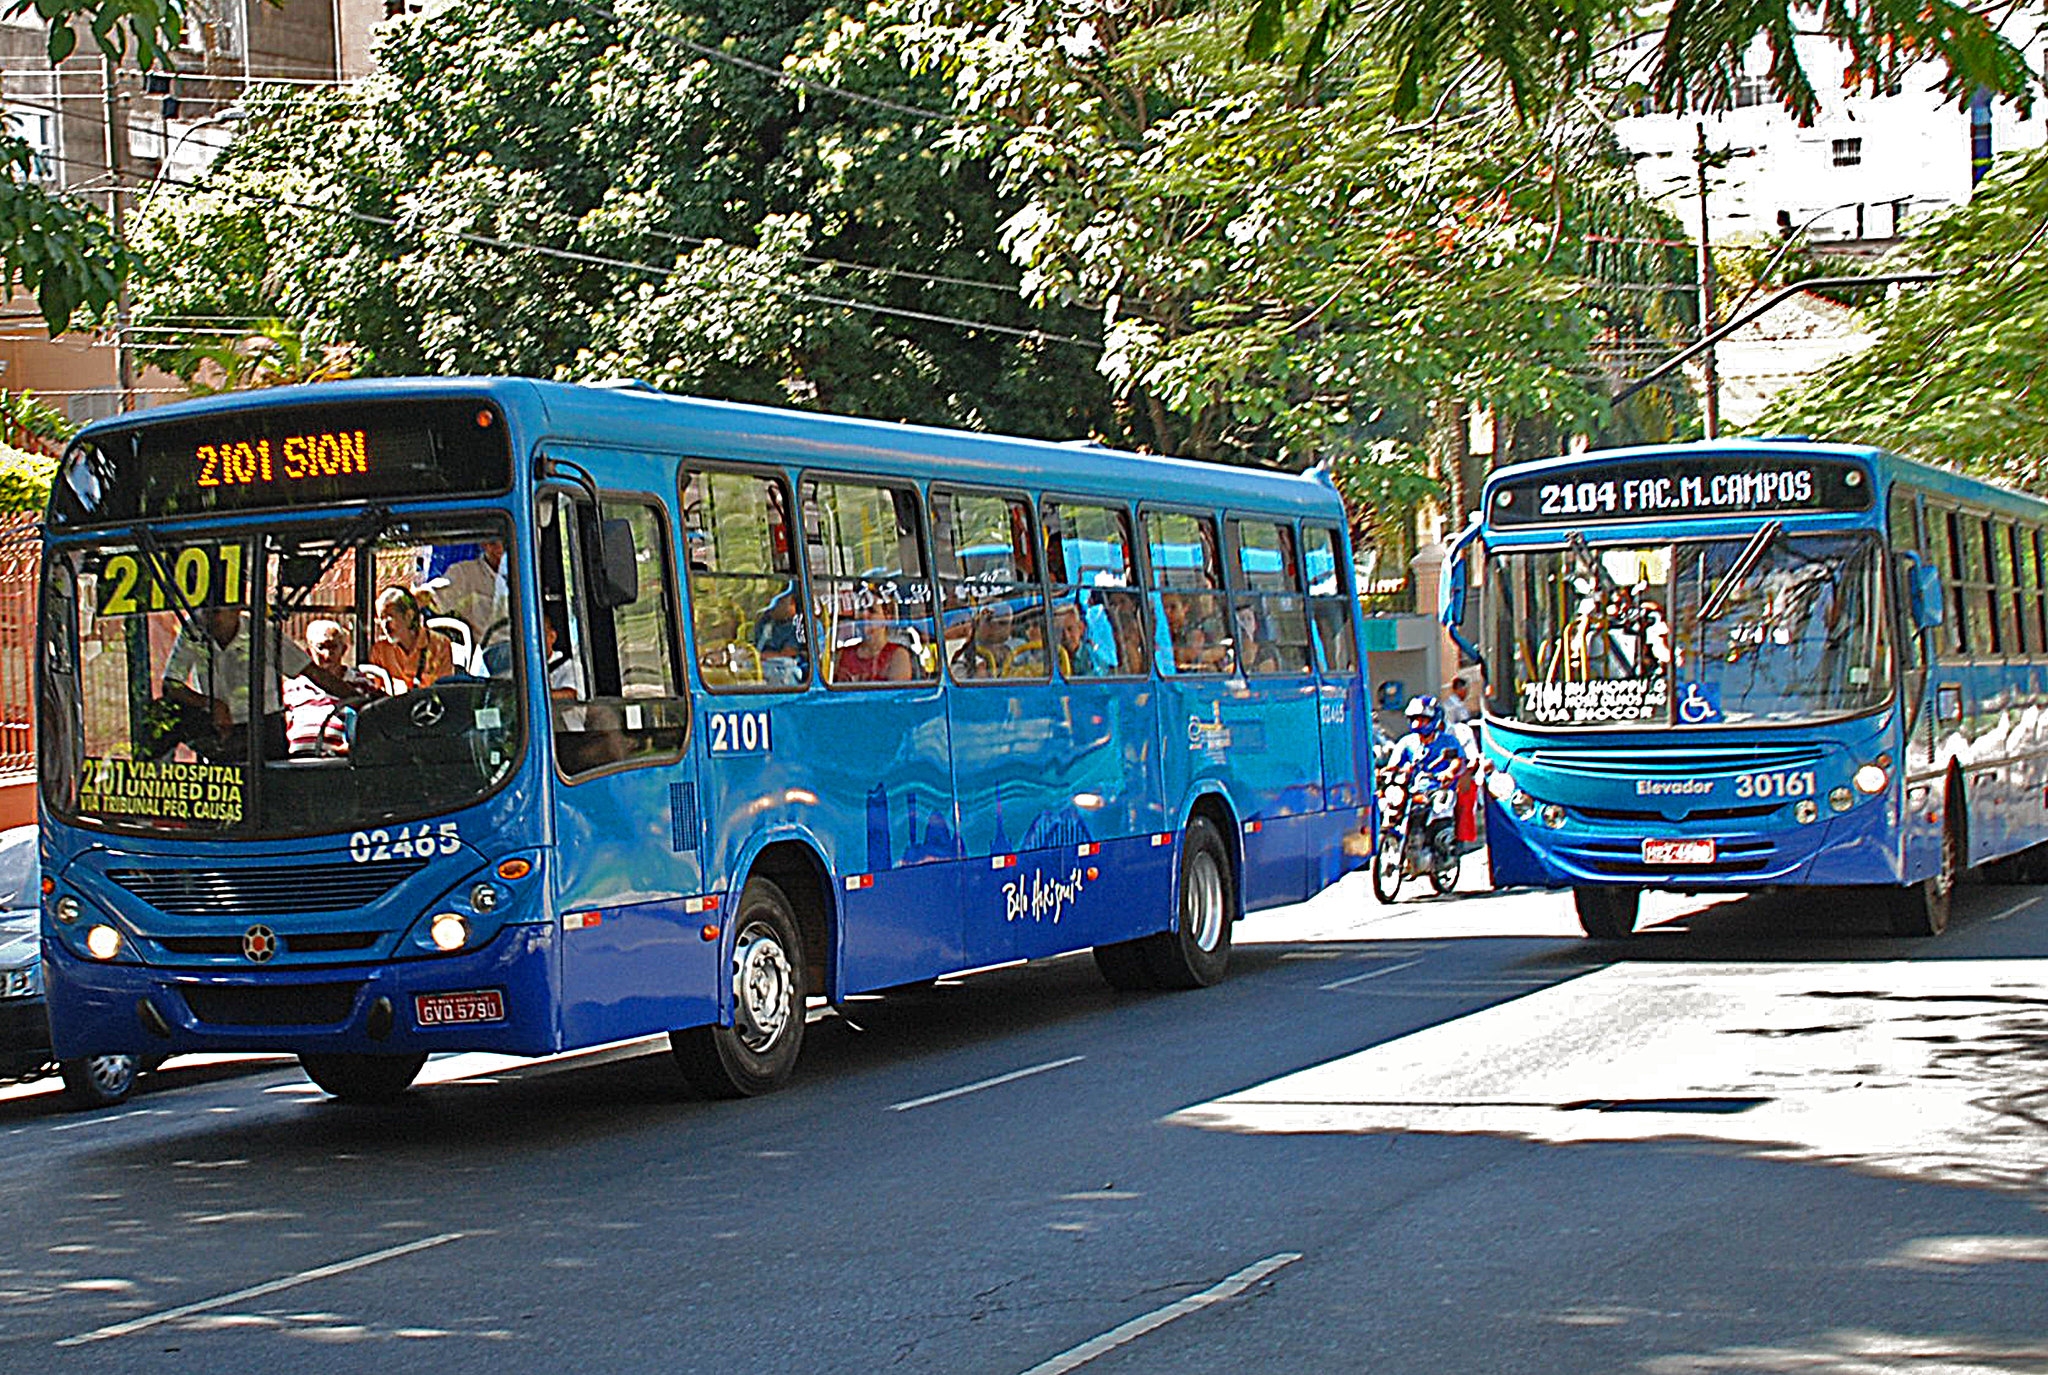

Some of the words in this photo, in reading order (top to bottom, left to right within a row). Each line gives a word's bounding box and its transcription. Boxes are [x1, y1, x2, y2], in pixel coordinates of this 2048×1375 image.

[197, 440, 273, 487] 2101
[283, 431, 366, 478] SION
[1540, 482, 1617, 514] 2104
[1535, 707, 1570, 721] VIA
[711, 713, 769, 751] 2101
[81, 759, 124, 795] 2101
[128, 760, 156, 779] VIA
[160, 763, 244, 785] HOSPITAL
[126, 779, 202, 800] UNIMED
[207, 784, 242, 803] DIA
[1636, 779, 1714, 795] Elevador
[1735, 771, 1815, 798] 30161
[80, 794, 99, 811] VIA
[103, 796, 160, 816] TRIBUNAL
[163, 800, 191, 819] PEQ.
[194, 802, 242, 822] CAUSAS
[350, 822, 461, 863] 02465
